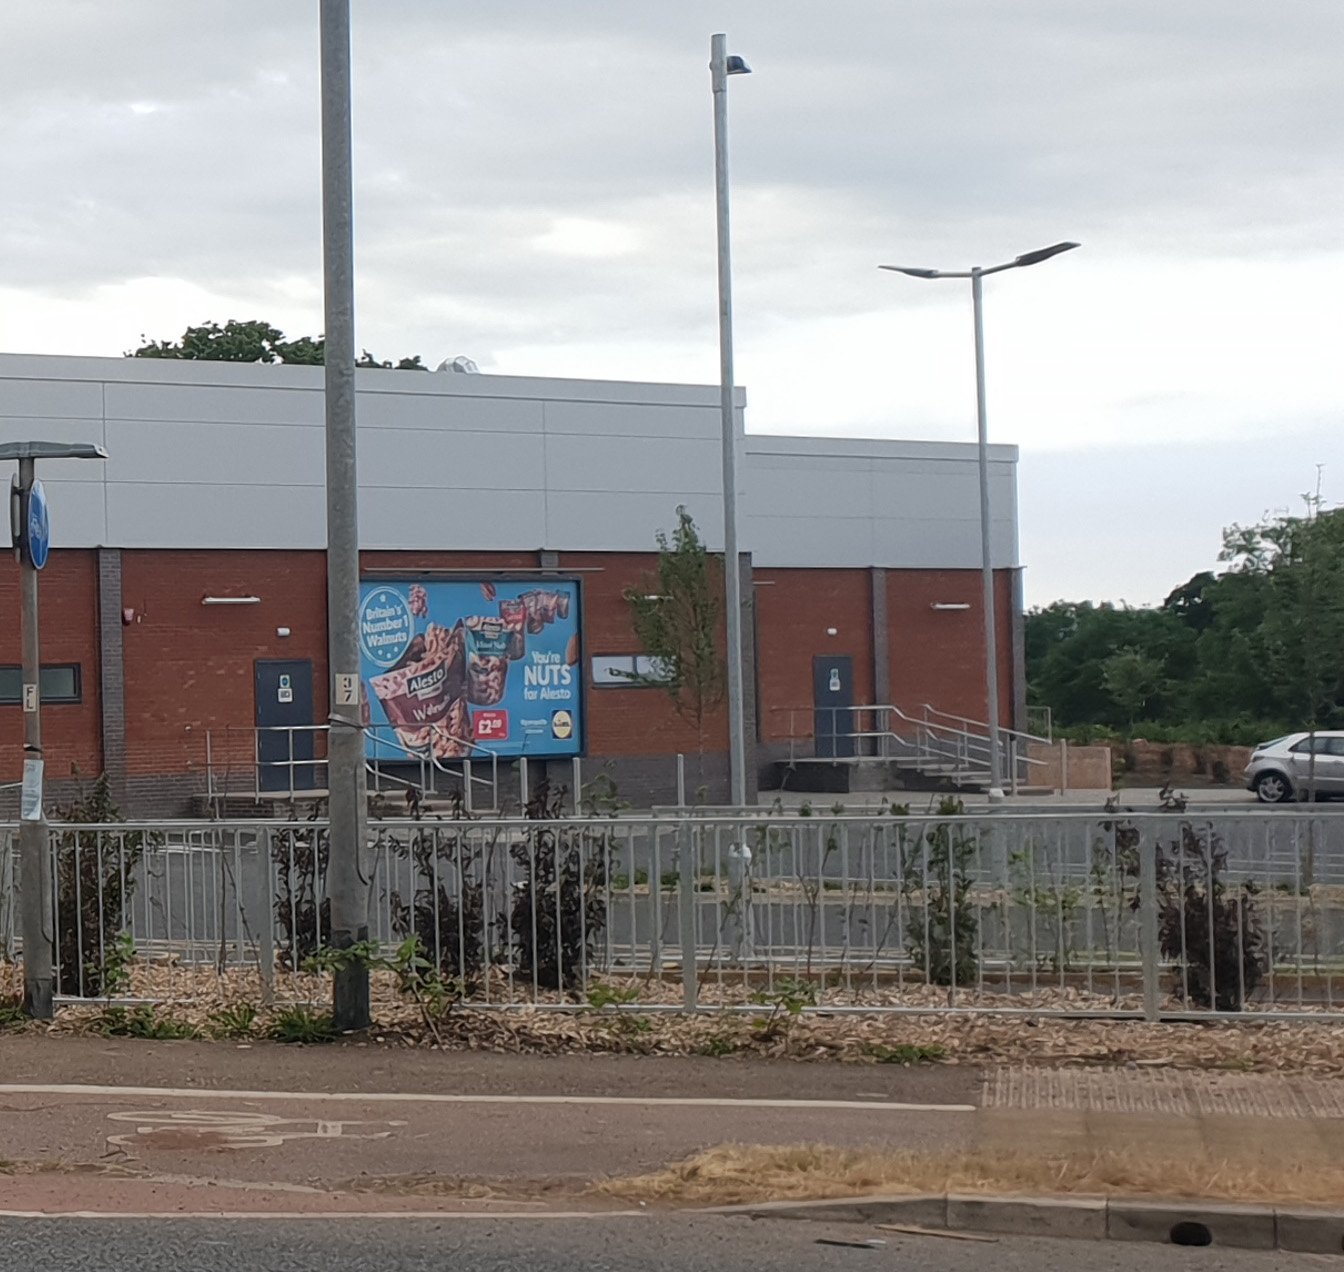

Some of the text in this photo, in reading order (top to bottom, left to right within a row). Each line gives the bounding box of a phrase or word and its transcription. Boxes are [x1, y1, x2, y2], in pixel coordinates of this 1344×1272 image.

[363, 618, 402, 634] Number
[410, 669, 444, 692] Alesto
[524, 664, 572, 686] NUTS
[524, 687, 572, 700] for Alesto
